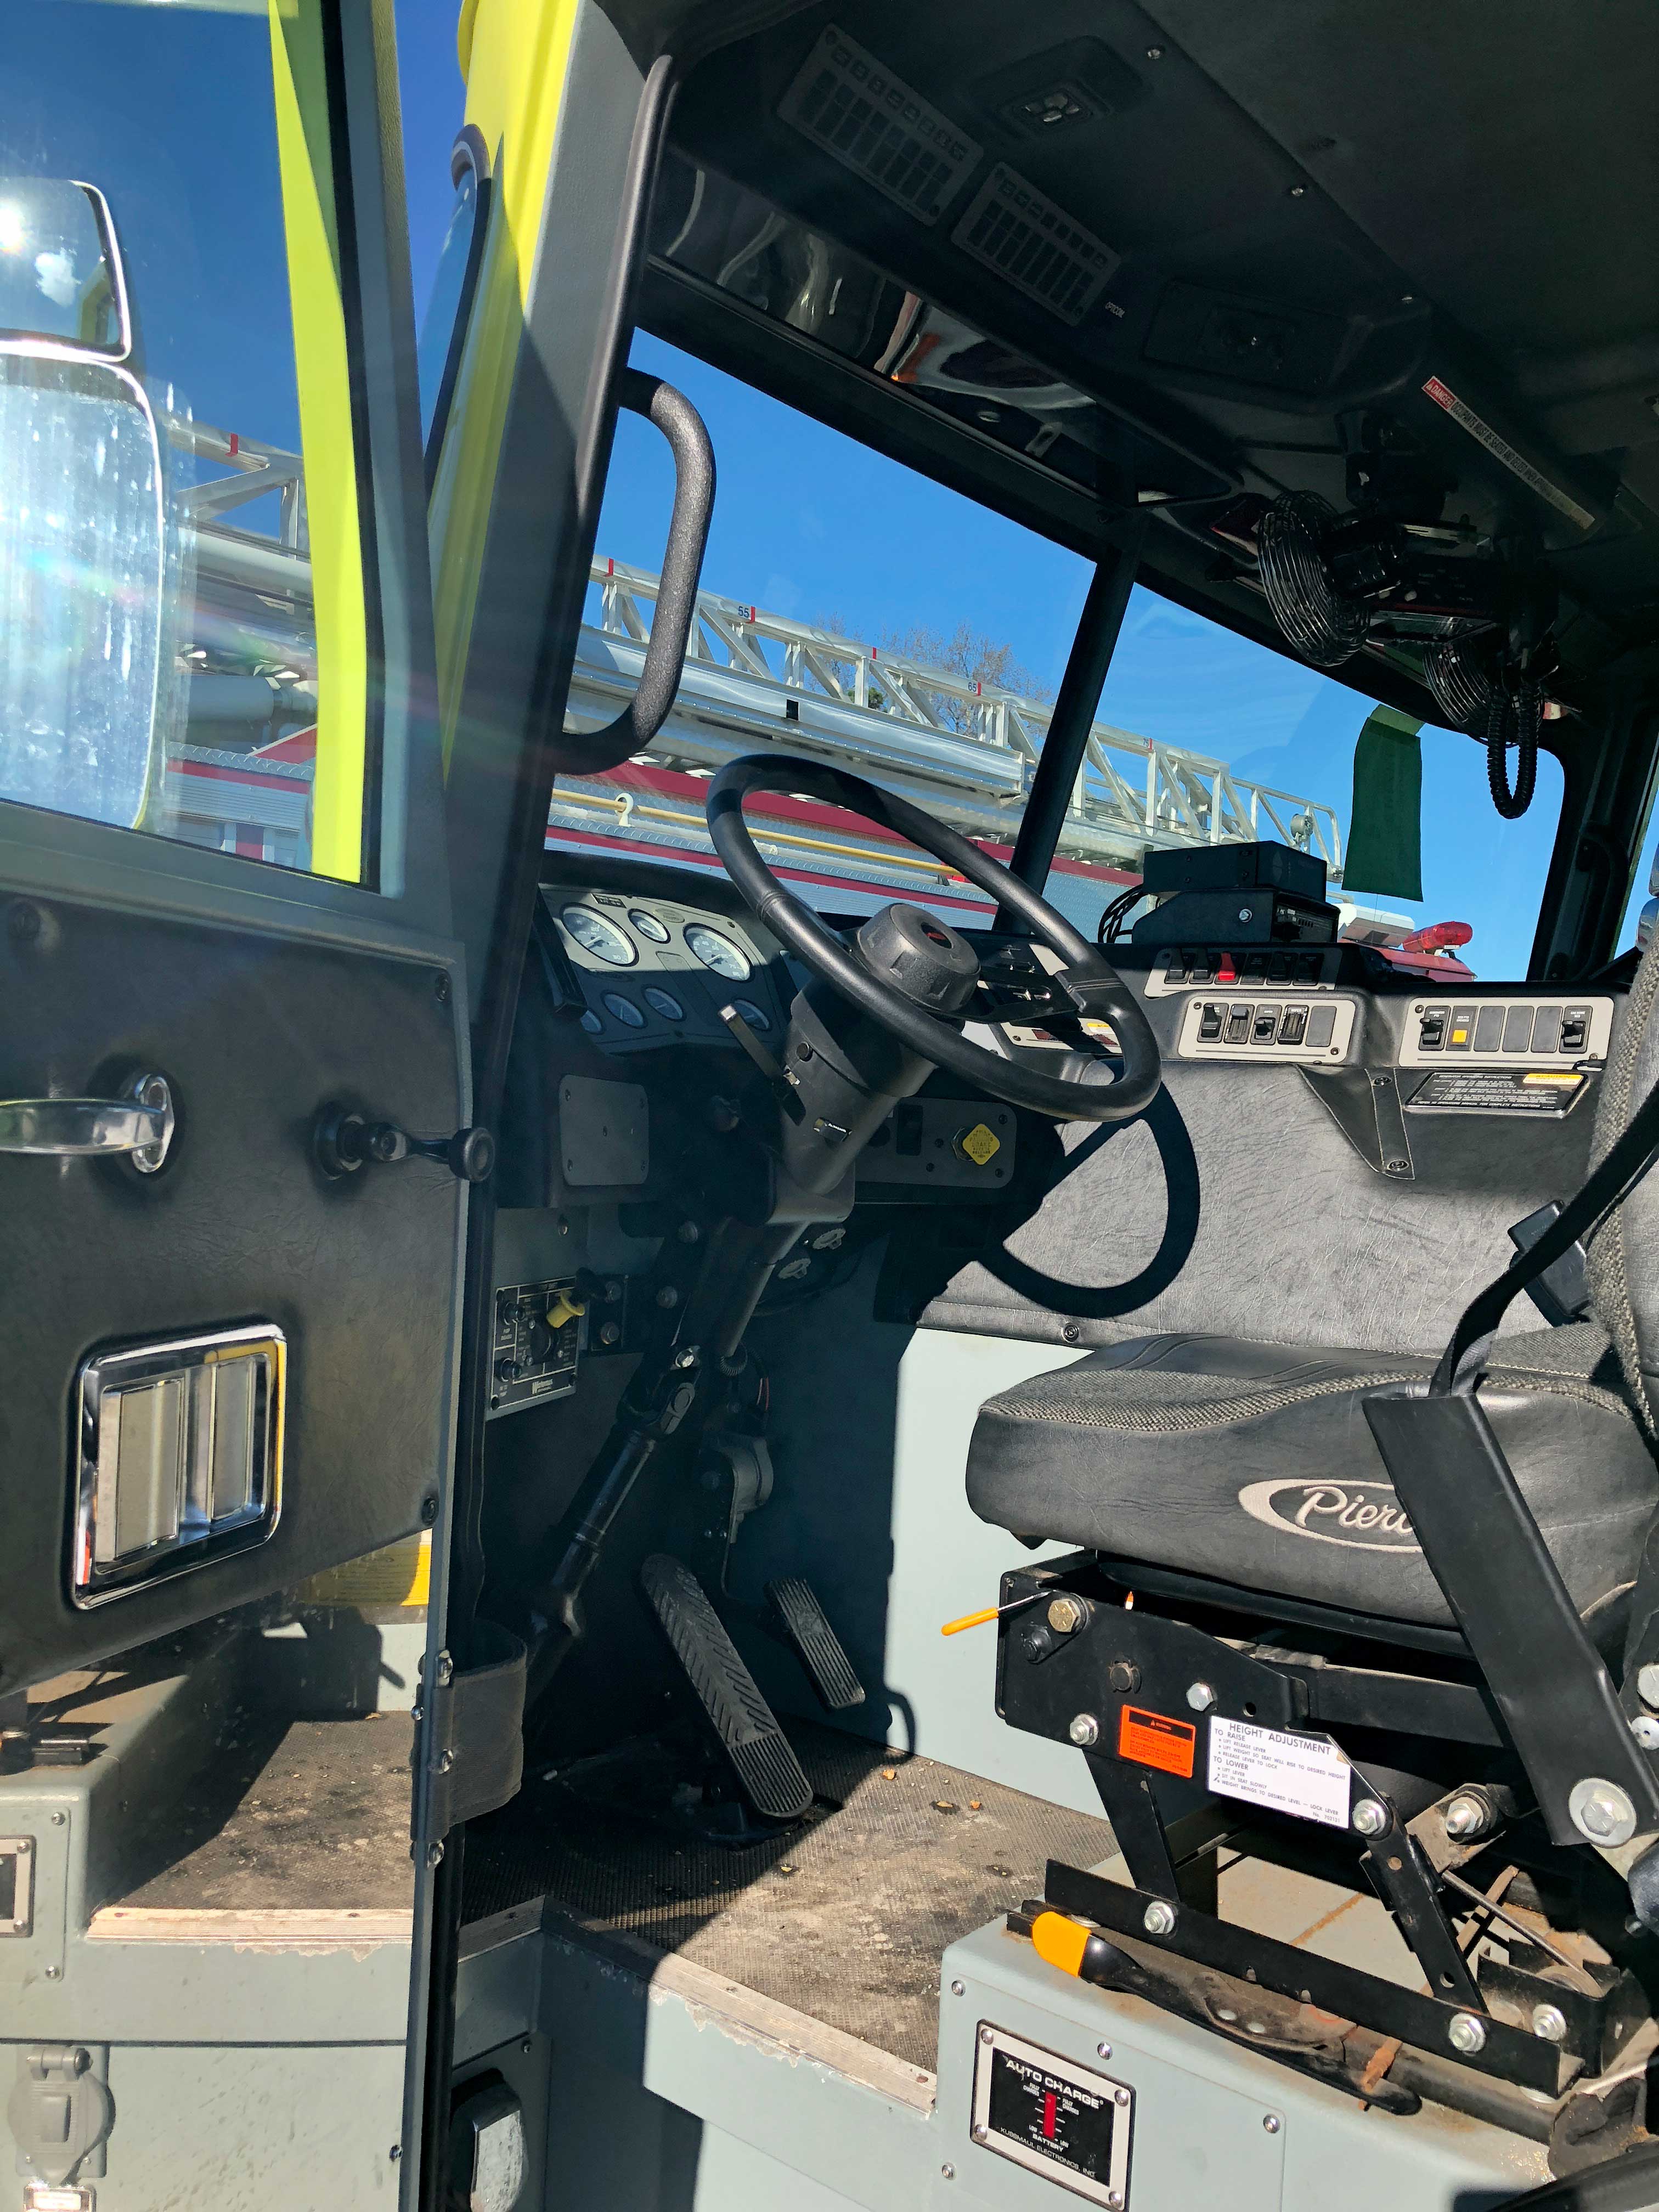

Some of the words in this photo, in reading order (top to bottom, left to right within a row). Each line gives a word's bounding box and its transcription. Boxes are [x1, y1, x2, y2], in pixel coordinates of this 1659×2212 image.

[1431, 385, 1453, 407] DANGER
[738, 606, 749, 618] 55
[968, 682, 977, 692] 65
[1143, 737, 1149, 747] 75
[1295, 1486, 1413, 1534] Pierc
[1227, 1731, 1245, 1741] RAISE
[1229, 1723, 1263, 1738] HEIGHT
[1268, 1733, 1331, 1755] ADJUSTMENT
[1233, 1741, 1251, 1750] RELEASE
[1226, 1759, 1249, 1770] LOWER
[1328, 1772, 1346, 1780] HEIGHT
[1250, 1781, 1267, 1789] SLOWLY
[1268, 1792, 1286, 1801] DESIRED
[1006, 2059, 1042, 2083] AUTO
[1029, 2082, 1040, 2091] FULLY
[1062, 2098, 1074, 2107] FULLY
[1001, 2127, 1035, 2148] KUSSMAUL
[1032, 2133, 1064, 2152] BATTERY
[1060, 2140, 1069, 2148] LOW
